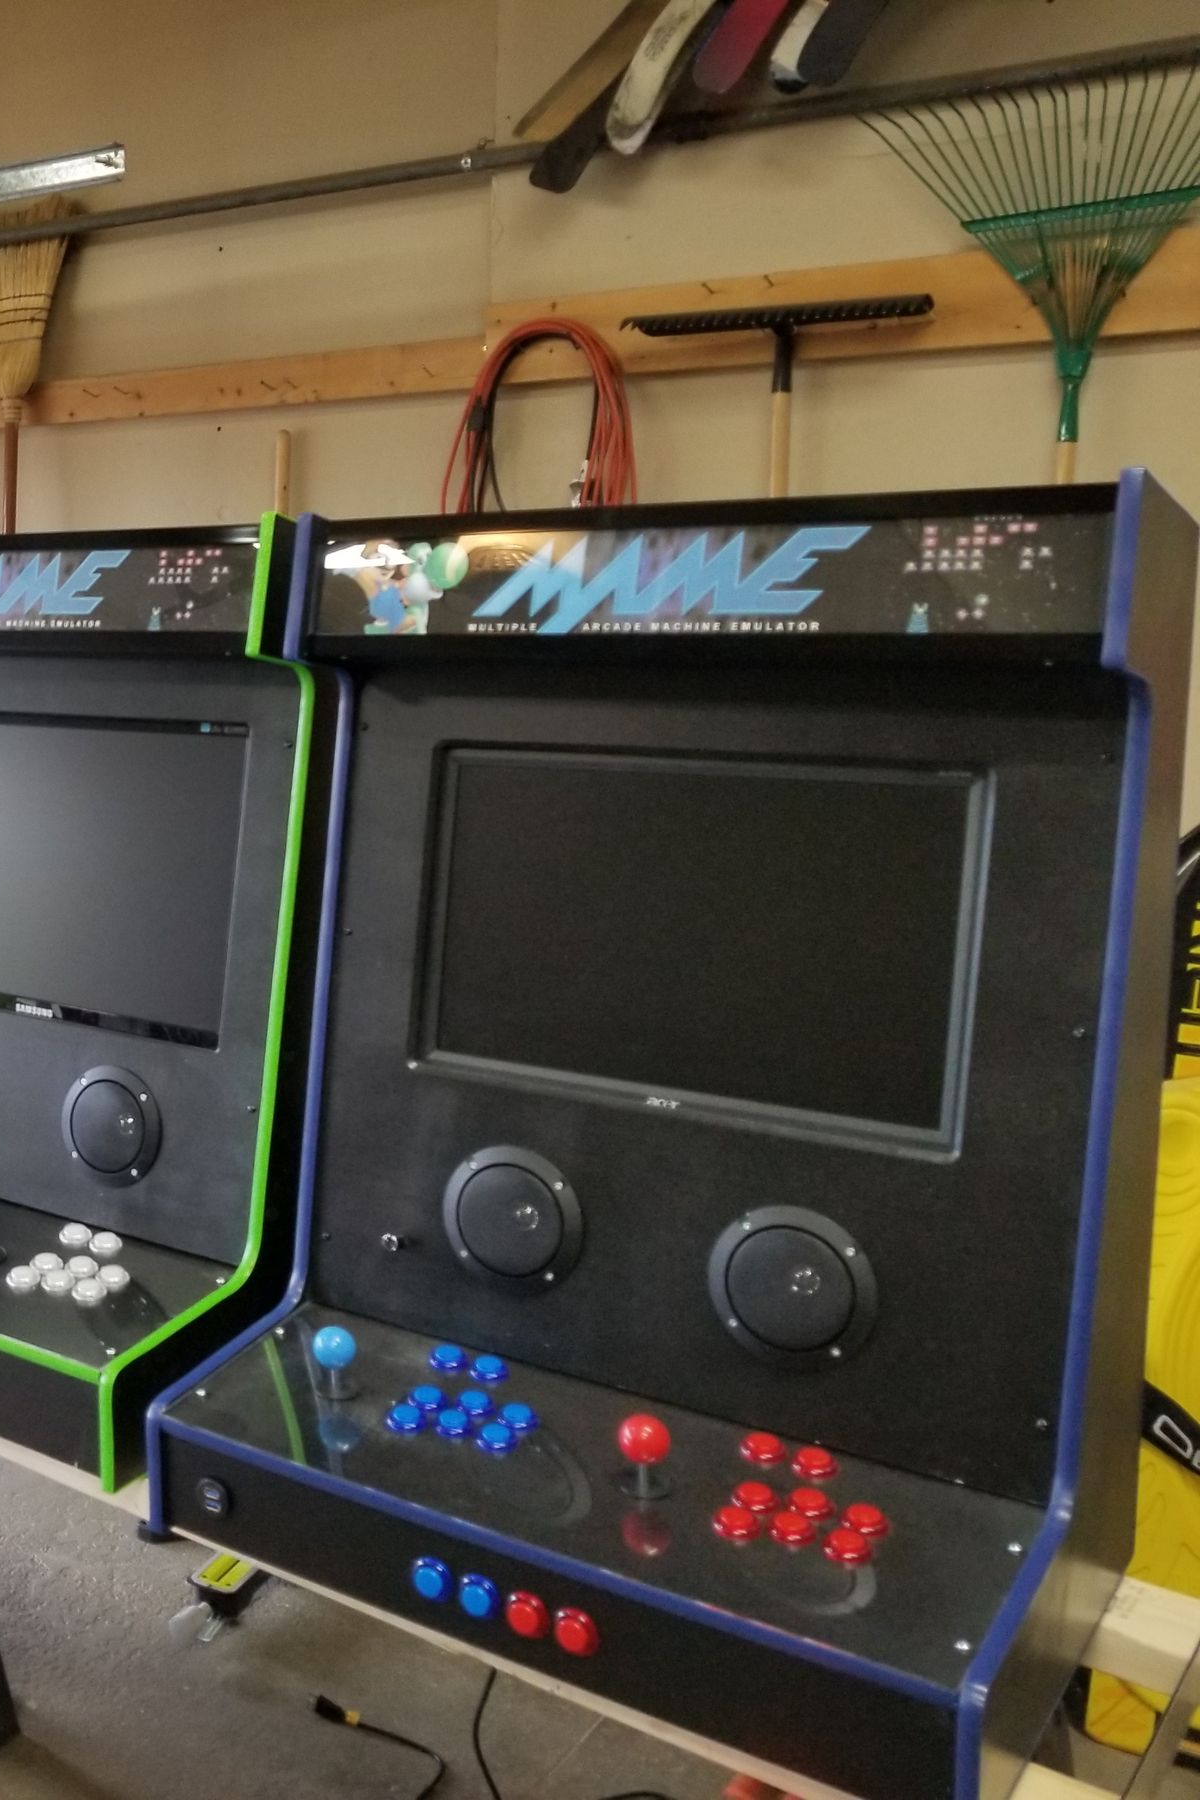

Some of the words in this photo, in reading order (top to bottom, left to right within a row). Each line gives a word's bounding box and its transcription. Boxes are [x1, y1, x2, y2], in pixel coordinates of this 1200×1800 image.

[472, 526, 871, 635] MAME
[6, 619, 46, 628] MACHINE
[51, 619, 101, 628] EMULATOR
[467, 623, 538, 632] MULTIPLE
[582, 622, 641, 632] ARCADE
[651, 622, 721, 631] MACHINE
[730, 621, 820, 631] EMULATOR
